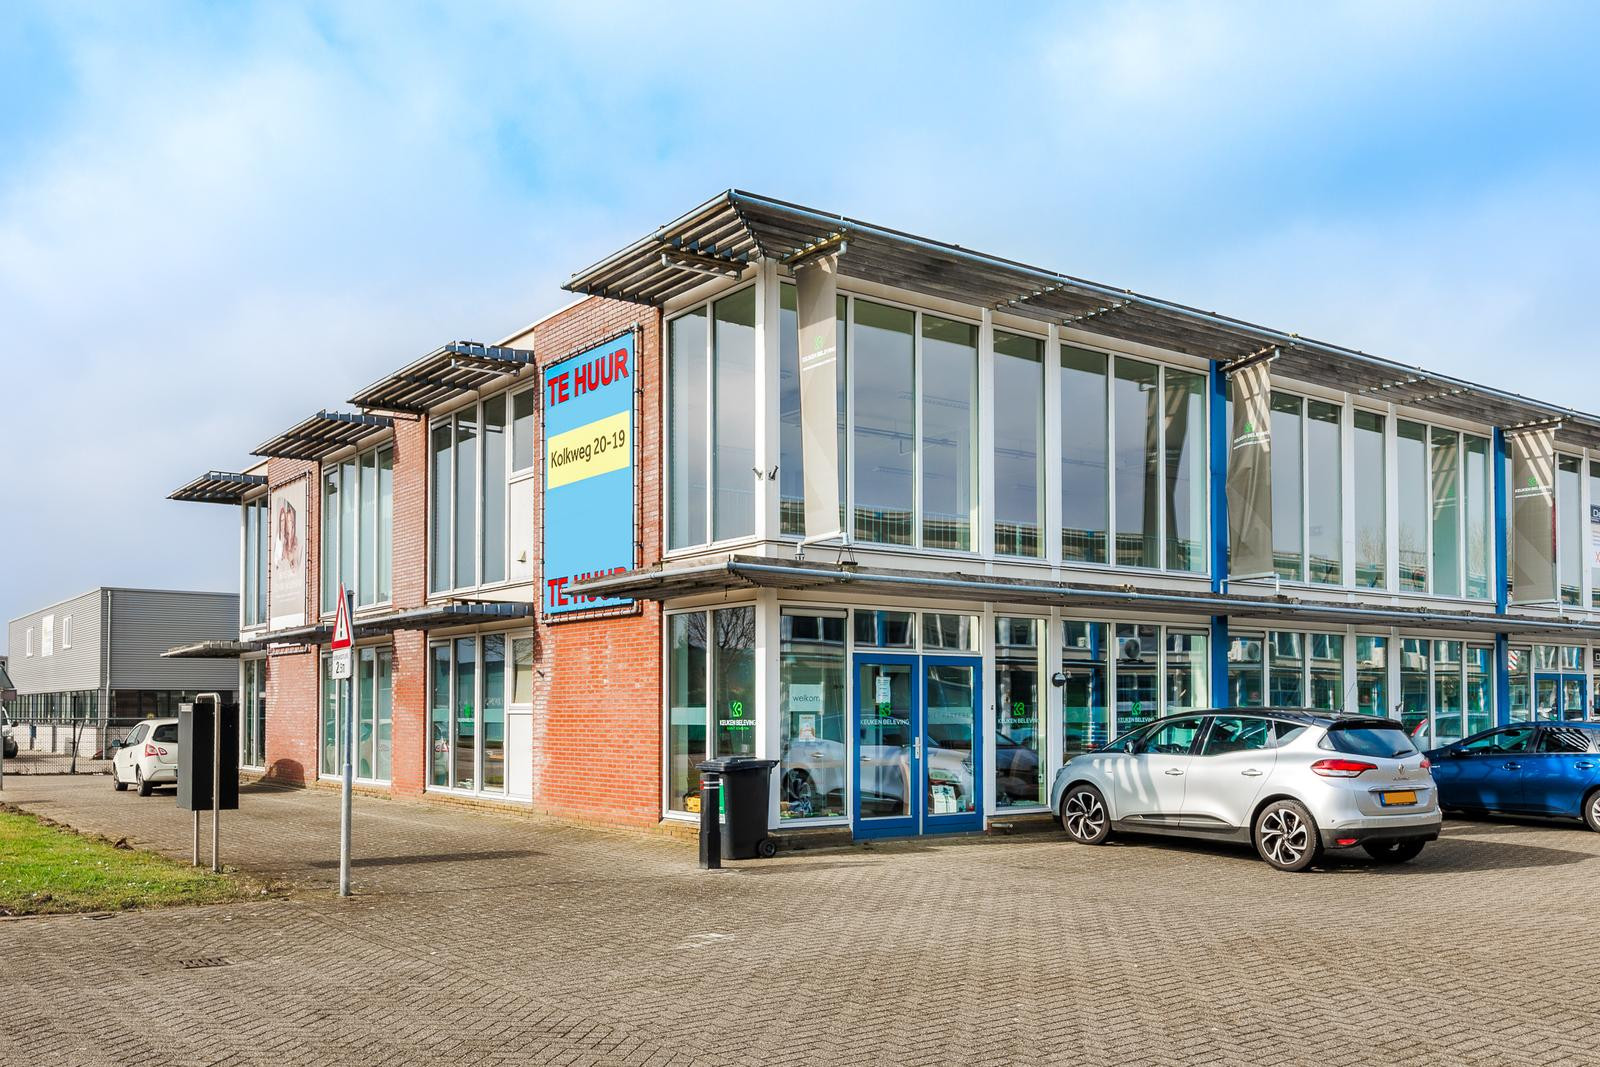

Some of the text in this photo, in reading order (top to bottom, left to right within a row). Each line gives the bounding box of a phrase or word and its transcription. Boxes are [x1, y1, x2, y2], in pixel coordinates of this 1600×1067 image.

[548, 348, 629, 406] TE HUUR
[551, 429, 626, 469] Kolkweg 20-19
[547, 567, 626, 607] TE HU
